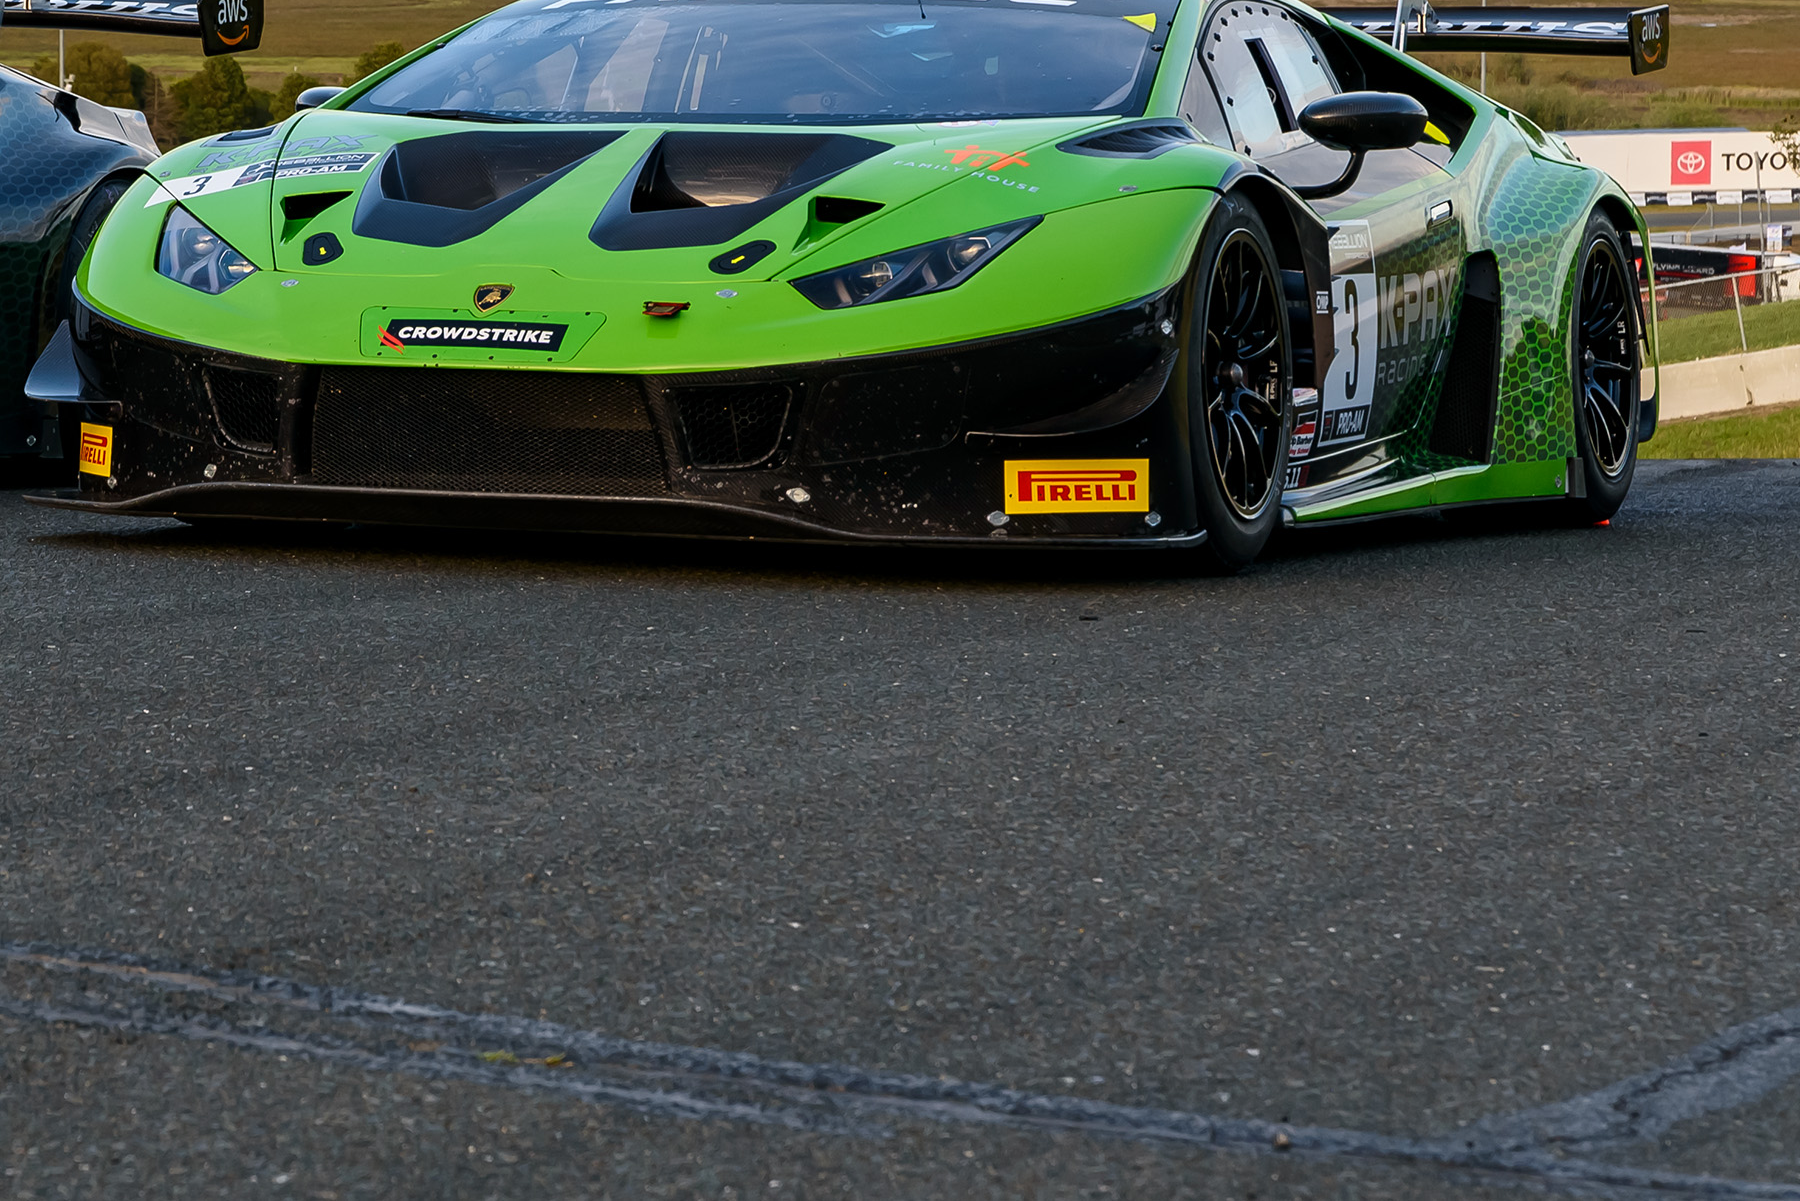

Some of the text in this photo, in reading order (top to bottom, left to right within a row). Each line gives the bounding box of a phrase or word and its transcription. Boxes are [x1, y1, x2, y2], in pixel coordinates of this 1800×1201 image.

[1642, 12, 1660, 42] aws
[197, 135, 378, 168] K-PAX
[183, 176, 213, 196] 3
[276, 165, 347, 178] PRO-AM
[893, 160, 1040, 193] FAMILY HOUSE
[1379, 267, 1456, 349] K-PAX
[398, 326, 554, 344] CROWDSTRIKE
[1345, 279, 1359, 400] 3
[1269, 359, 1278, 373] LF
[1336, 409, 1365, 436] PRO-AM
[1017, 470, 1137, 501] PIRELLI
